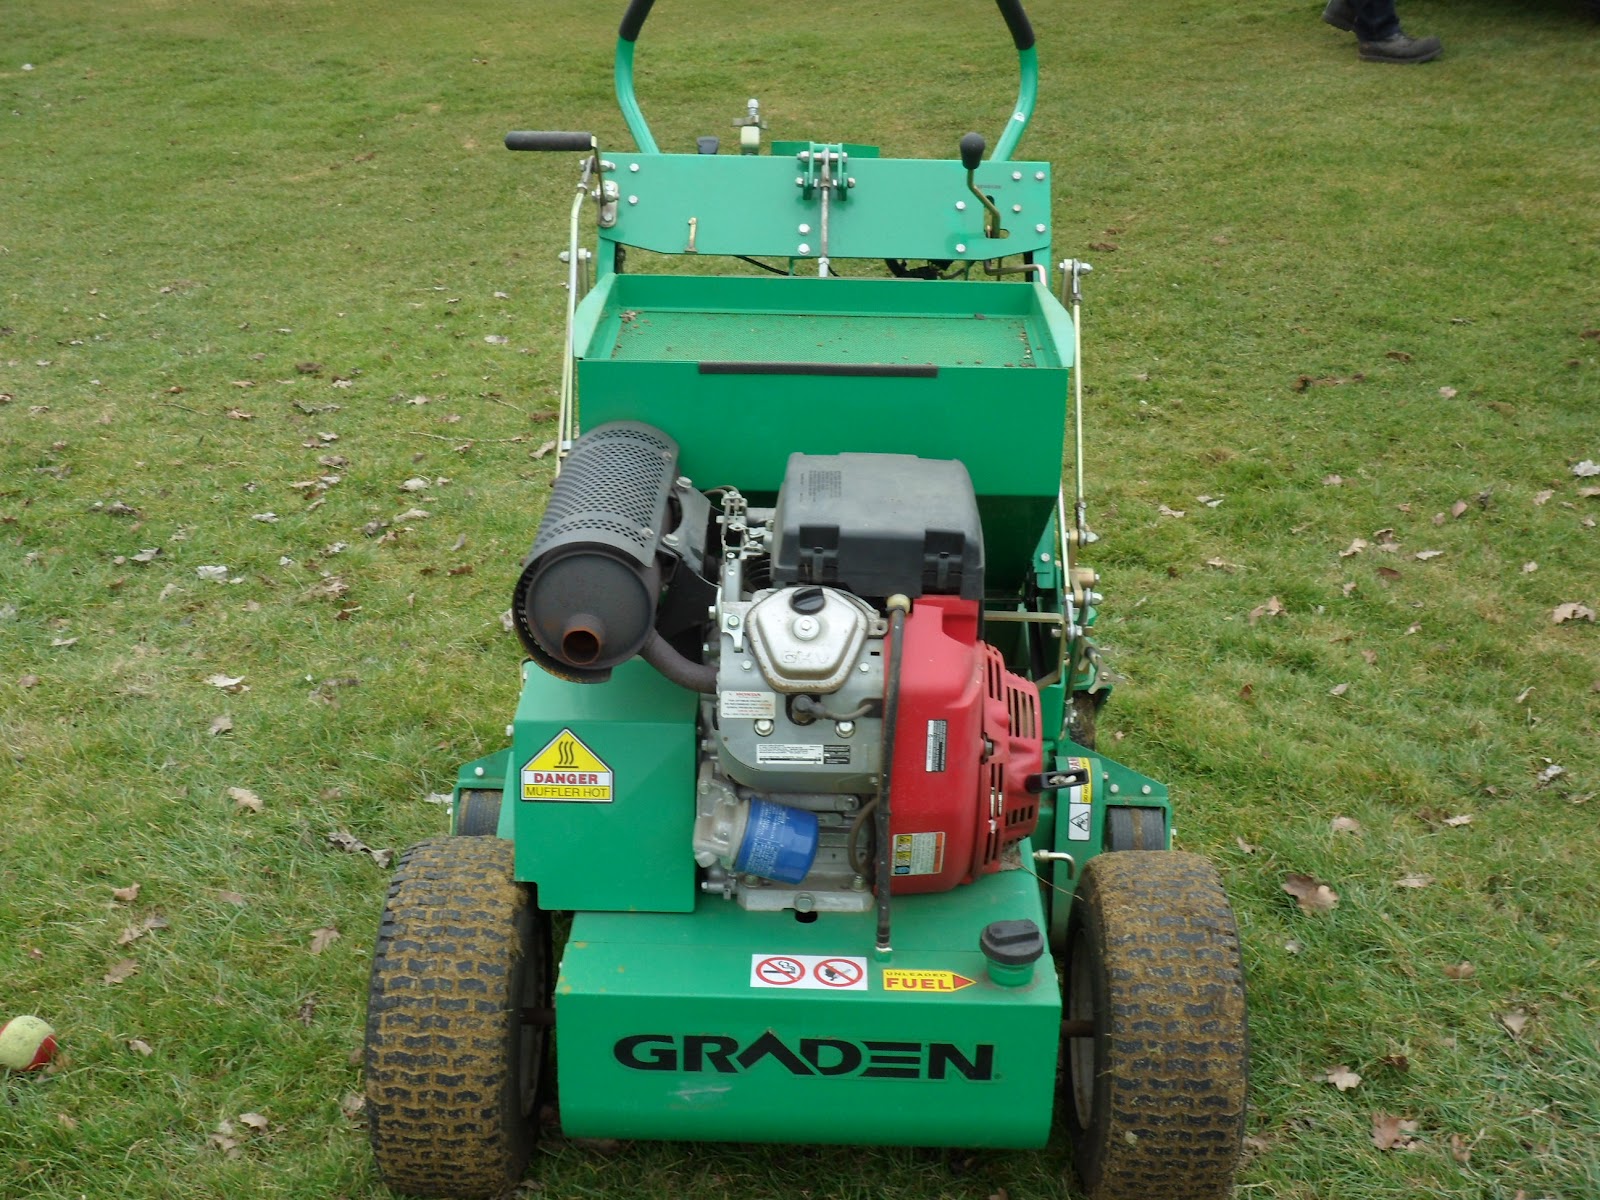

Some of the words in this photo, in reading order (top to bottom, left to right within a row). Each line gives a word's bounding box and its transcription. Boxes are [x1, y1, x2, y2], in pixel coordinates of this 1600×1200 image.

[533, 772, 598, 785] DANGER
[526, 786, 580, 797] MUFFLER
[583, 787, 607, 798] HOT
[886, 977, 951, 990] FUEL
[613, 1030, 994, 1081] GRADEN
